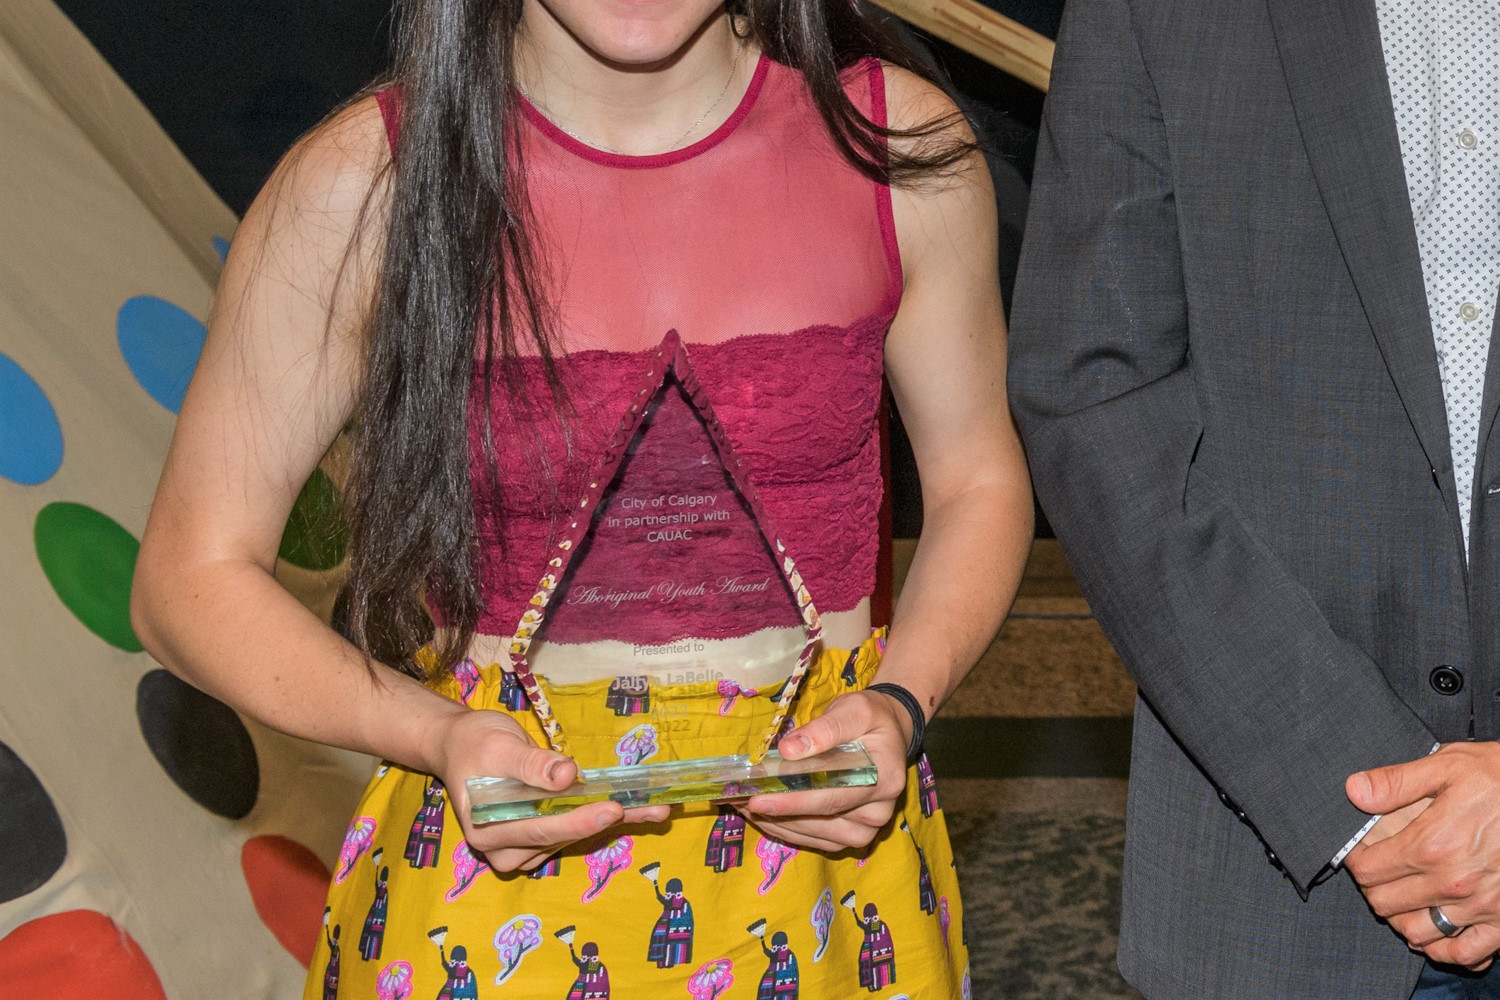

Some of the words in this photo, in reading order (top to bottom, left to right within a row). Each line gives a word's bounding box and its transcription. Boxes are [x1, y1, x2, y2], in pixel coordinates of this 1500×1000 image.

[621, 497, 647, 510] City
[651, 495, 666, 507] of
[668, 494, 718, 507] Calgary
[608, 516, 621, 527] in
[624, 512, 699, 528] partnership
[703, 510, 730, 521] with
[647, 529, 692, 542] CAUAC
[567, 585, 655, 609] Aboriginal
[656, 580, 707, 603] Youth
[709, 576, 771, 595] Award
[634, 643, 691, 657] Presented
[694, 643, 705, 652] to
[667, 669, 724, 685] LaBelle
